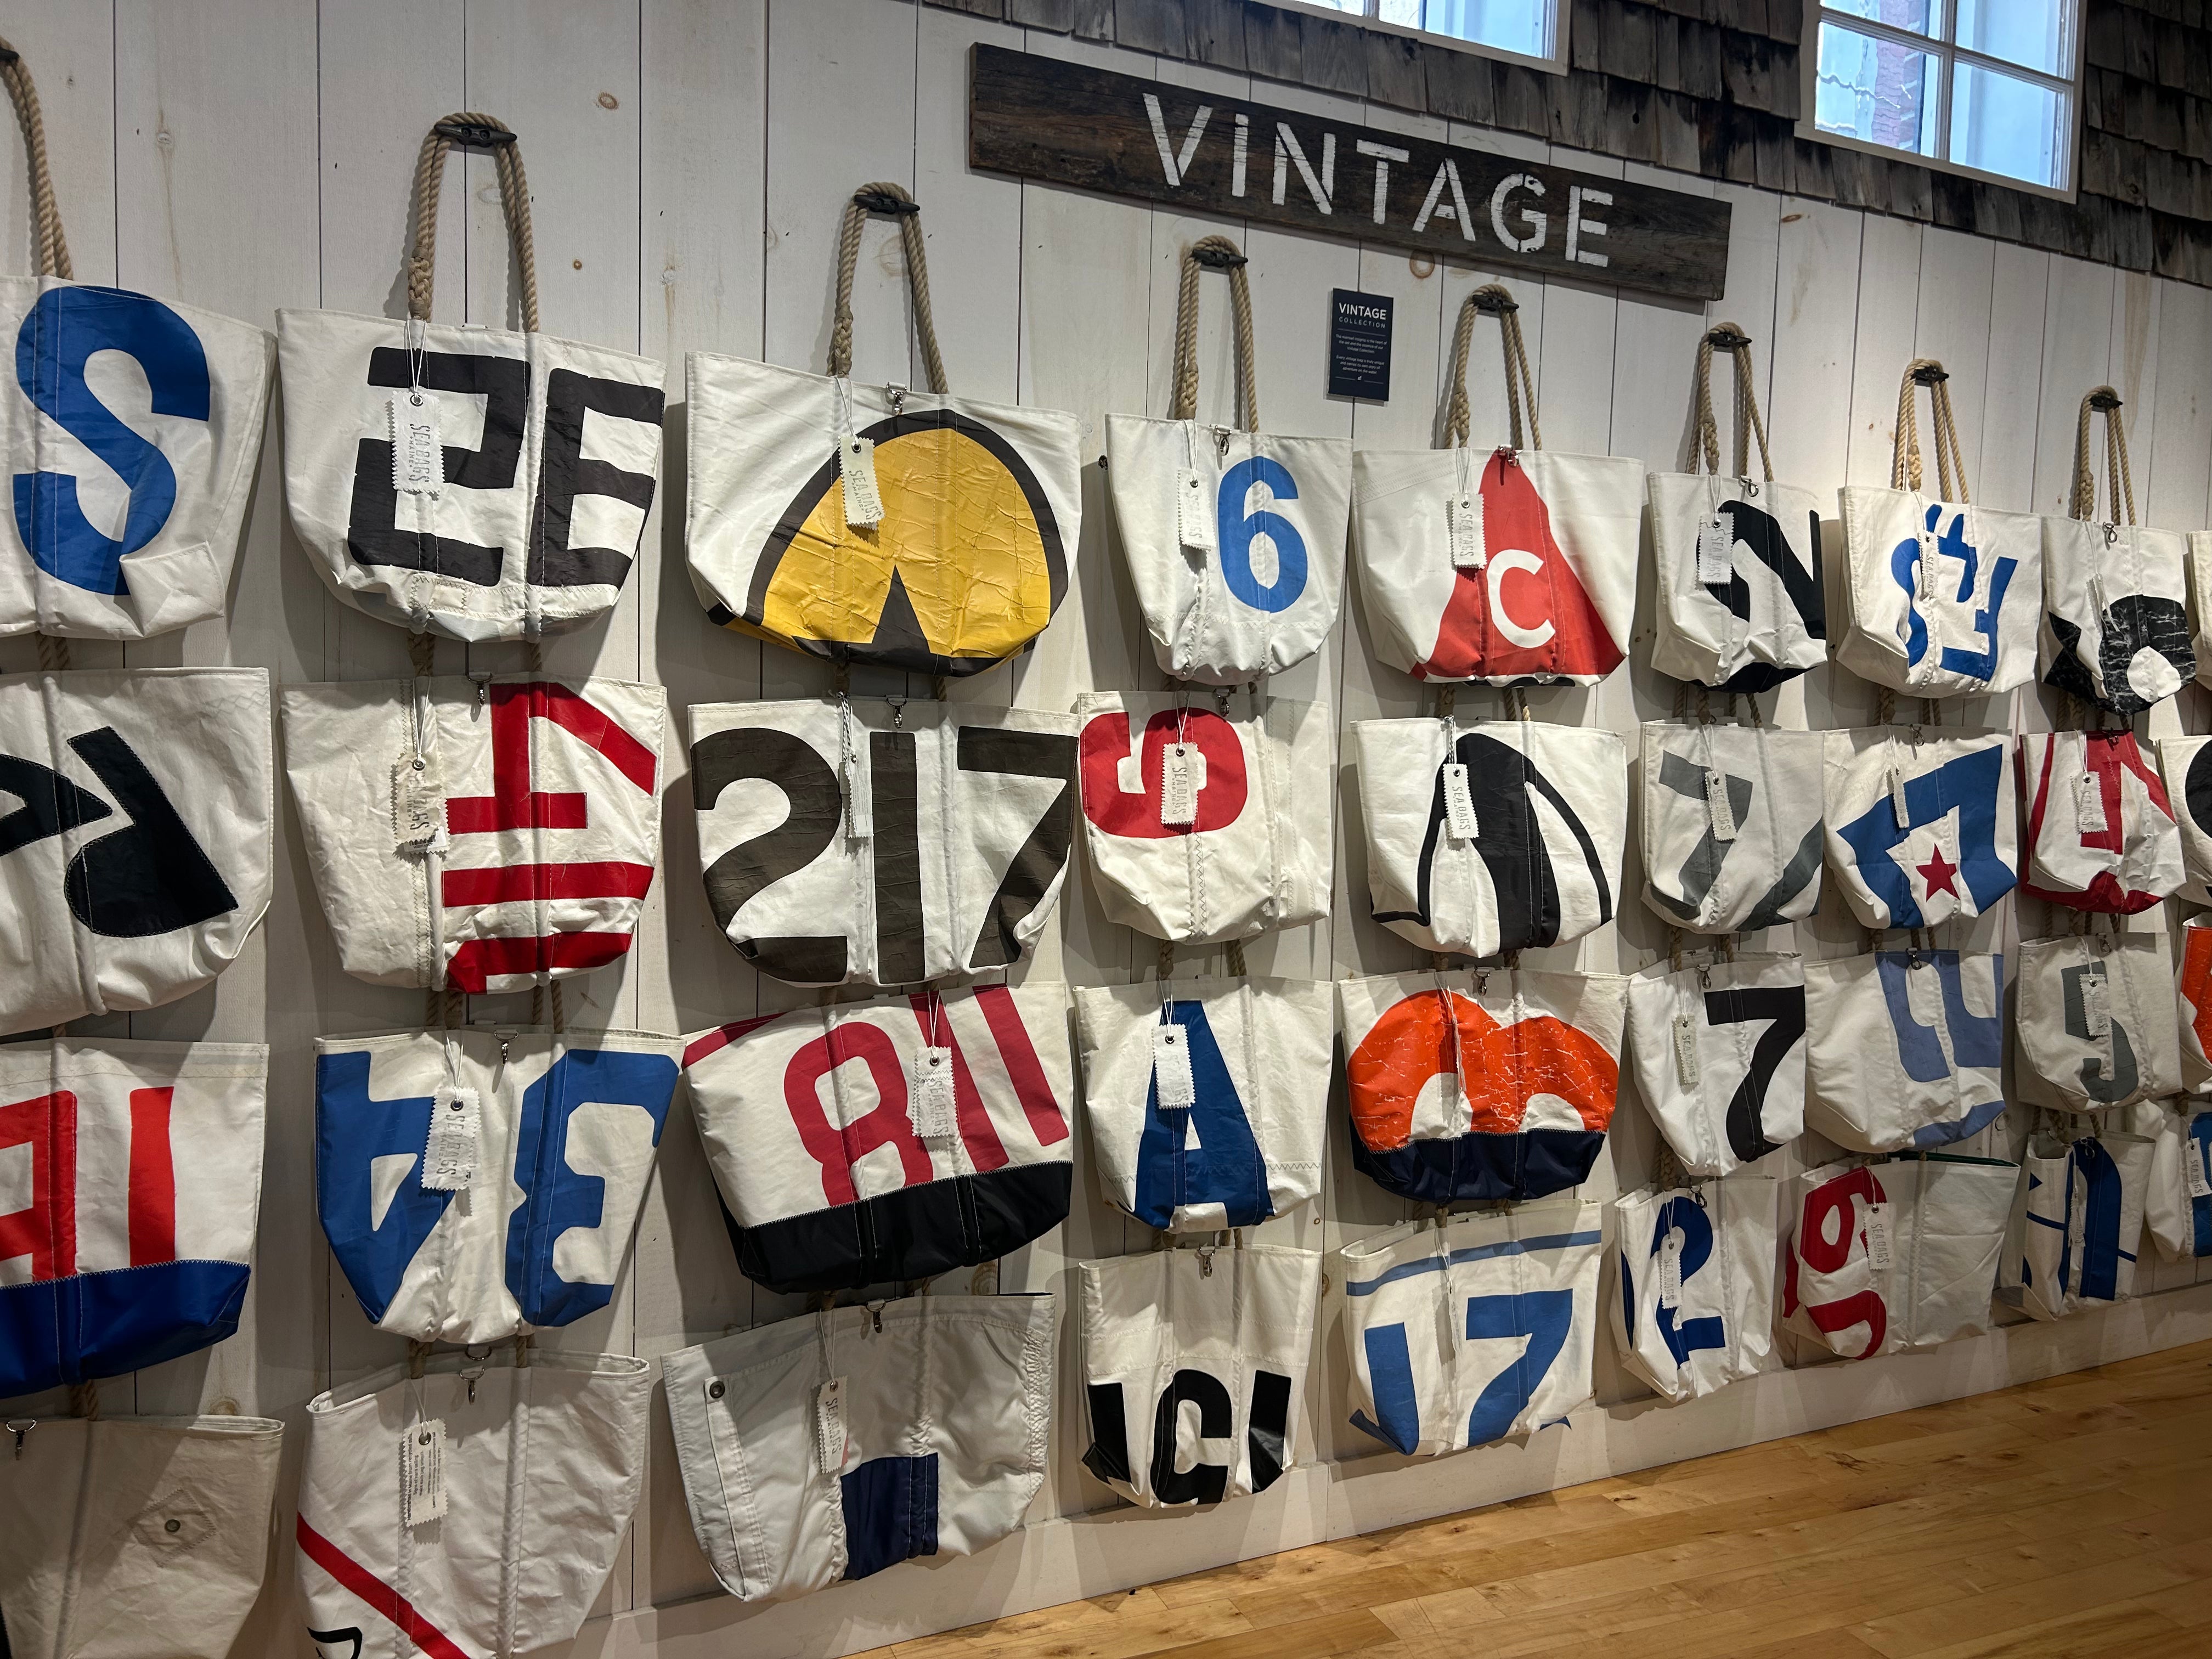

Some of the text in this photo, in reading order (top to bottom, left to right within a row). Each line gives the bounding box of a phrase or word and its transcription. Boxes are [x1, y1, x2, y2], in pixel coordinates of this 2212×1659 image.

[1142, 92, 1613, 268] VINTAGE
[1339, 302, 1386, 320] VINTAGE
[1339, 317, 1386, 329] COLLECTION
[13, 285, 210, 595] S
[408, 424, 430, 482] SEA BAGS
[849, 470, 882, 520] SEA BAGS
[1218, 456, 1307, 613] 6
[1459, 514, 1474, 556] SEA BAGS
[1707, 537, 1724, 577] SEA BAGS
[1487, 549, 1555, 648] C
[1172, 768, 1187, 814] SEA BAGS
[1452, 786, 1471, 830] SEA BAGS
[690, 726, 1079, 984] 217
[1704, 984, 1805, 1163] 7
[927, 1080, 949, 1134] SEA BAGS
[1135, 1000, 1274, 1229] A
[437, 1114, 465, 1175] SEA BAGS
[1664, 1259, 1673, 1274] SEA
[1871, 1223, 1889, 1263] SEA BAGS
[1364, 1288, 1573, 1455] 17
[826, 1397, 841, 1454] SEA BAGS
